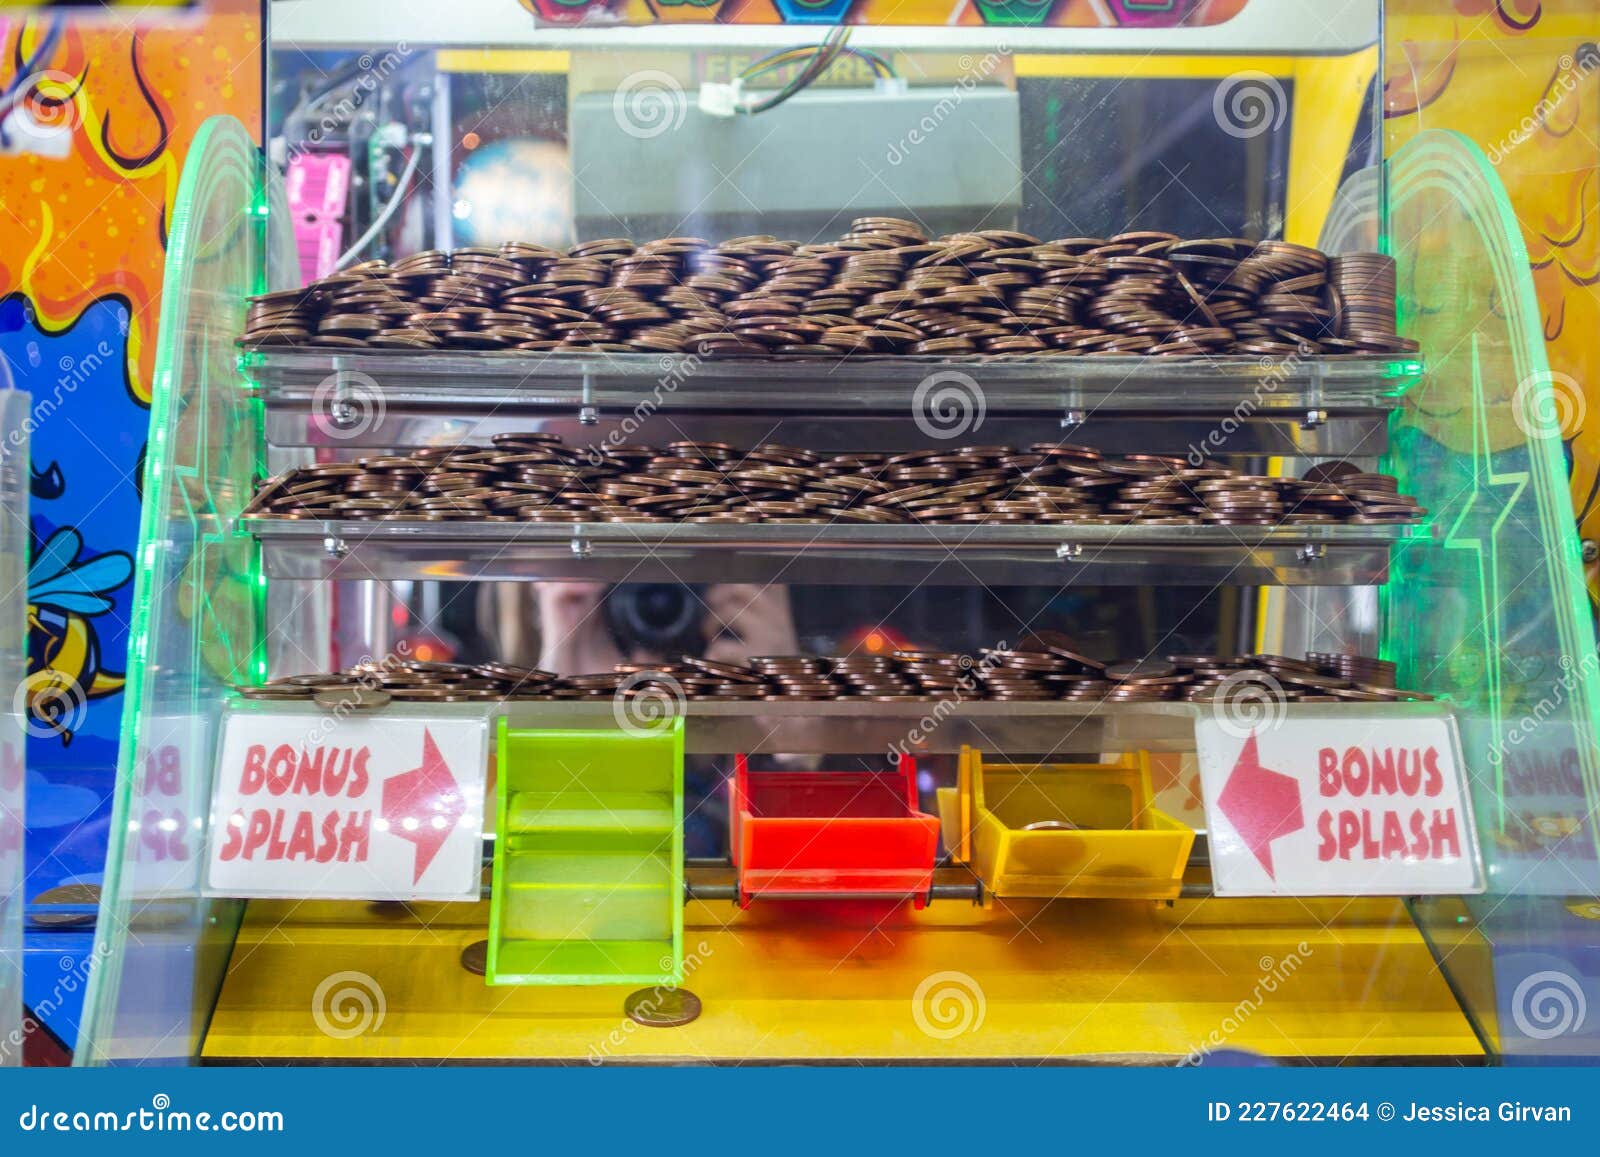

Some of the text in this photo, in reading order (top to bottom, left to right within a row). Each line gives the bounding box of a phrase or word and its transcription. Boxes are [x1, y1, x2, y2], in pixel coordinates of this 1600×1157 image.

[238, 744, 371, 799] BONUS
[1317, 745, 1444, 798] BONUS
[219, 808, 372, 863] SPLASH
[1316, 808, 1462, 862] SPLASH
